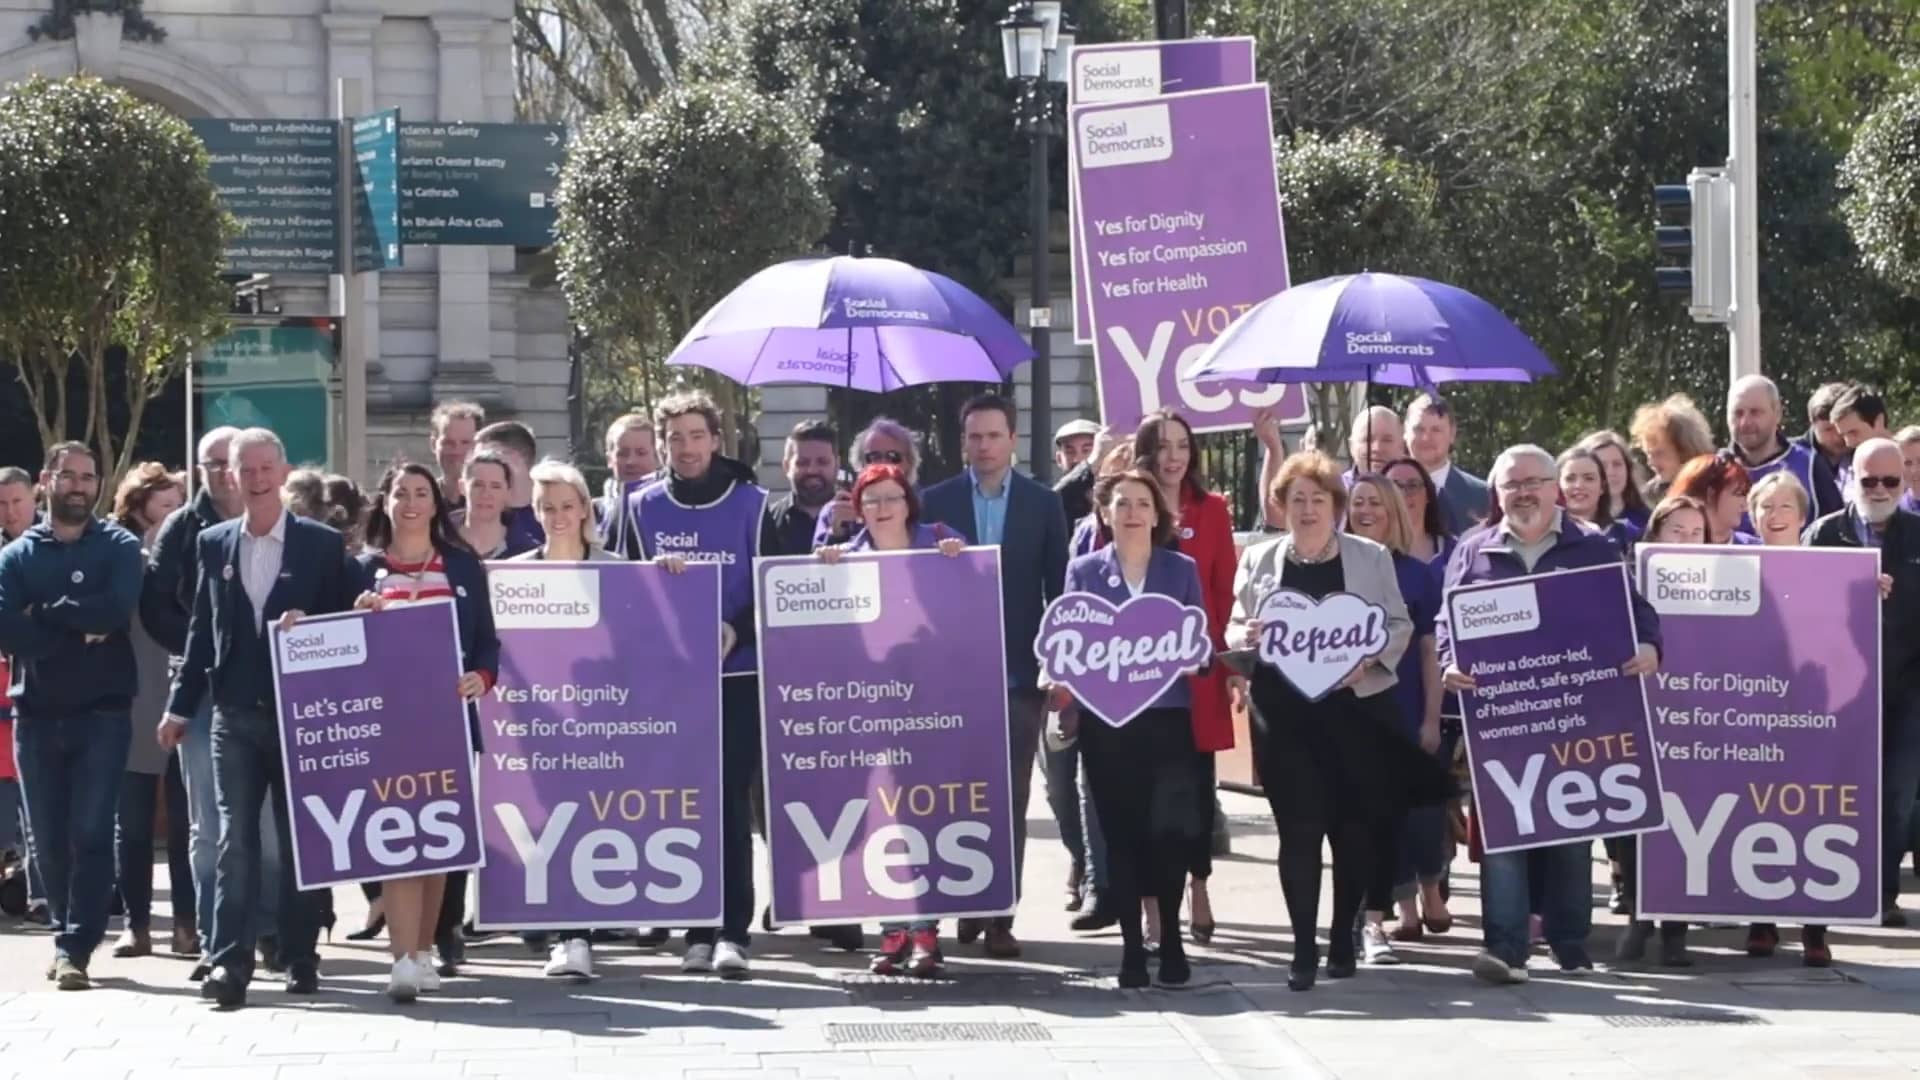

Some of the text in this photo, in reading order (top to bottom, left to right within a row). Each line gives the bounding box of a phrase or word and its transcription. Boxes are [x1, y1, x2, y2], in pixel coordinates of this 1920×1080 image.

[1083, 64, 1120, 77] Social
[1083, 76, 1154, 91] Democrats
[1086, 122, 1127, 139] Social
[1088, 135, 1165, 154] Democrats
[1094, 211, 1205, 236] Yes for Dignity
[1098, 238, 1247, 267] Yes for Compassion
[1102, 273, 1208, 299] Yes for Health
[843, 297, 887, 309] Social
[846, 307, 929, 321] Democrats
[1181, 304, 1253, 337] VOT
[1346, 332, 1392, 344] Social
[1347, 343, 1435, 357] Democrats
[655, 531, 699, 547] Social
[775, 577, 825, 596] Social
[1657, 568, 1707, 585] Social
[494, 583, 546, 600] Social
[776, 593, 872, 613] Democrats
[1657, 584, 1751, 602] Democrats
[494, 599, 591, 617] Democrats
[1052, 600, 1115, 627] SocDems
[1460, 599, 1497, 617] Social
[1462, 608, 1533, 630] Democrats
[286, 633, 325, 650] Social
[1262, 611, 1379, 663] Repeal
[288, 643, 360, 663] Democrats
[1045, 615, 1201, 683] Repeal
[1470, 647, 1593, 677] Allow a doctor-led,
[1540, 674, 1569, 690] safe
[1571, 667, 1618, 690] system
[1656, 672, 1790, 698] Yes for Dignity
[493, 684, 630, 706] Yes for Dignity
[778, 680, 914, 703] Yes for Dignity
[342, 696, 384, 716] care
[1476, 691, 1585, 719] of healthcare for
[493, 718, 677, 741] Yes for Compassion
[780, 712, 964, 737] Yes for Compassion
[1479, 713, 1587, 740] women and girls
[1656, 706, 1838, 732] Yes for Compassion
[296, 721, 382, 747] for those
[299, 748, 371, 773] in crisis
[781, 747, 913, 771] Yes for Health
[1551, 732, 1639, 767] VOTE
[1656, 741, 1786, 763] Yes for Health
[493, 752, 625, 772] Yes for Health
[372, 769, 459, 803] VOTE
[1483, 752, 1648, 836] Yes
[589, 789, 702, 822] VOTE
[877, 781, 991, 817] VOTE
[1749, 783, 1860, 817] VOTE
[303, 788, 466, 873] Yes
[493, 801, 703, 906] Yes
[784, 798, 995, 903] Yes
[1664, 791, 1861, 903] Yes
